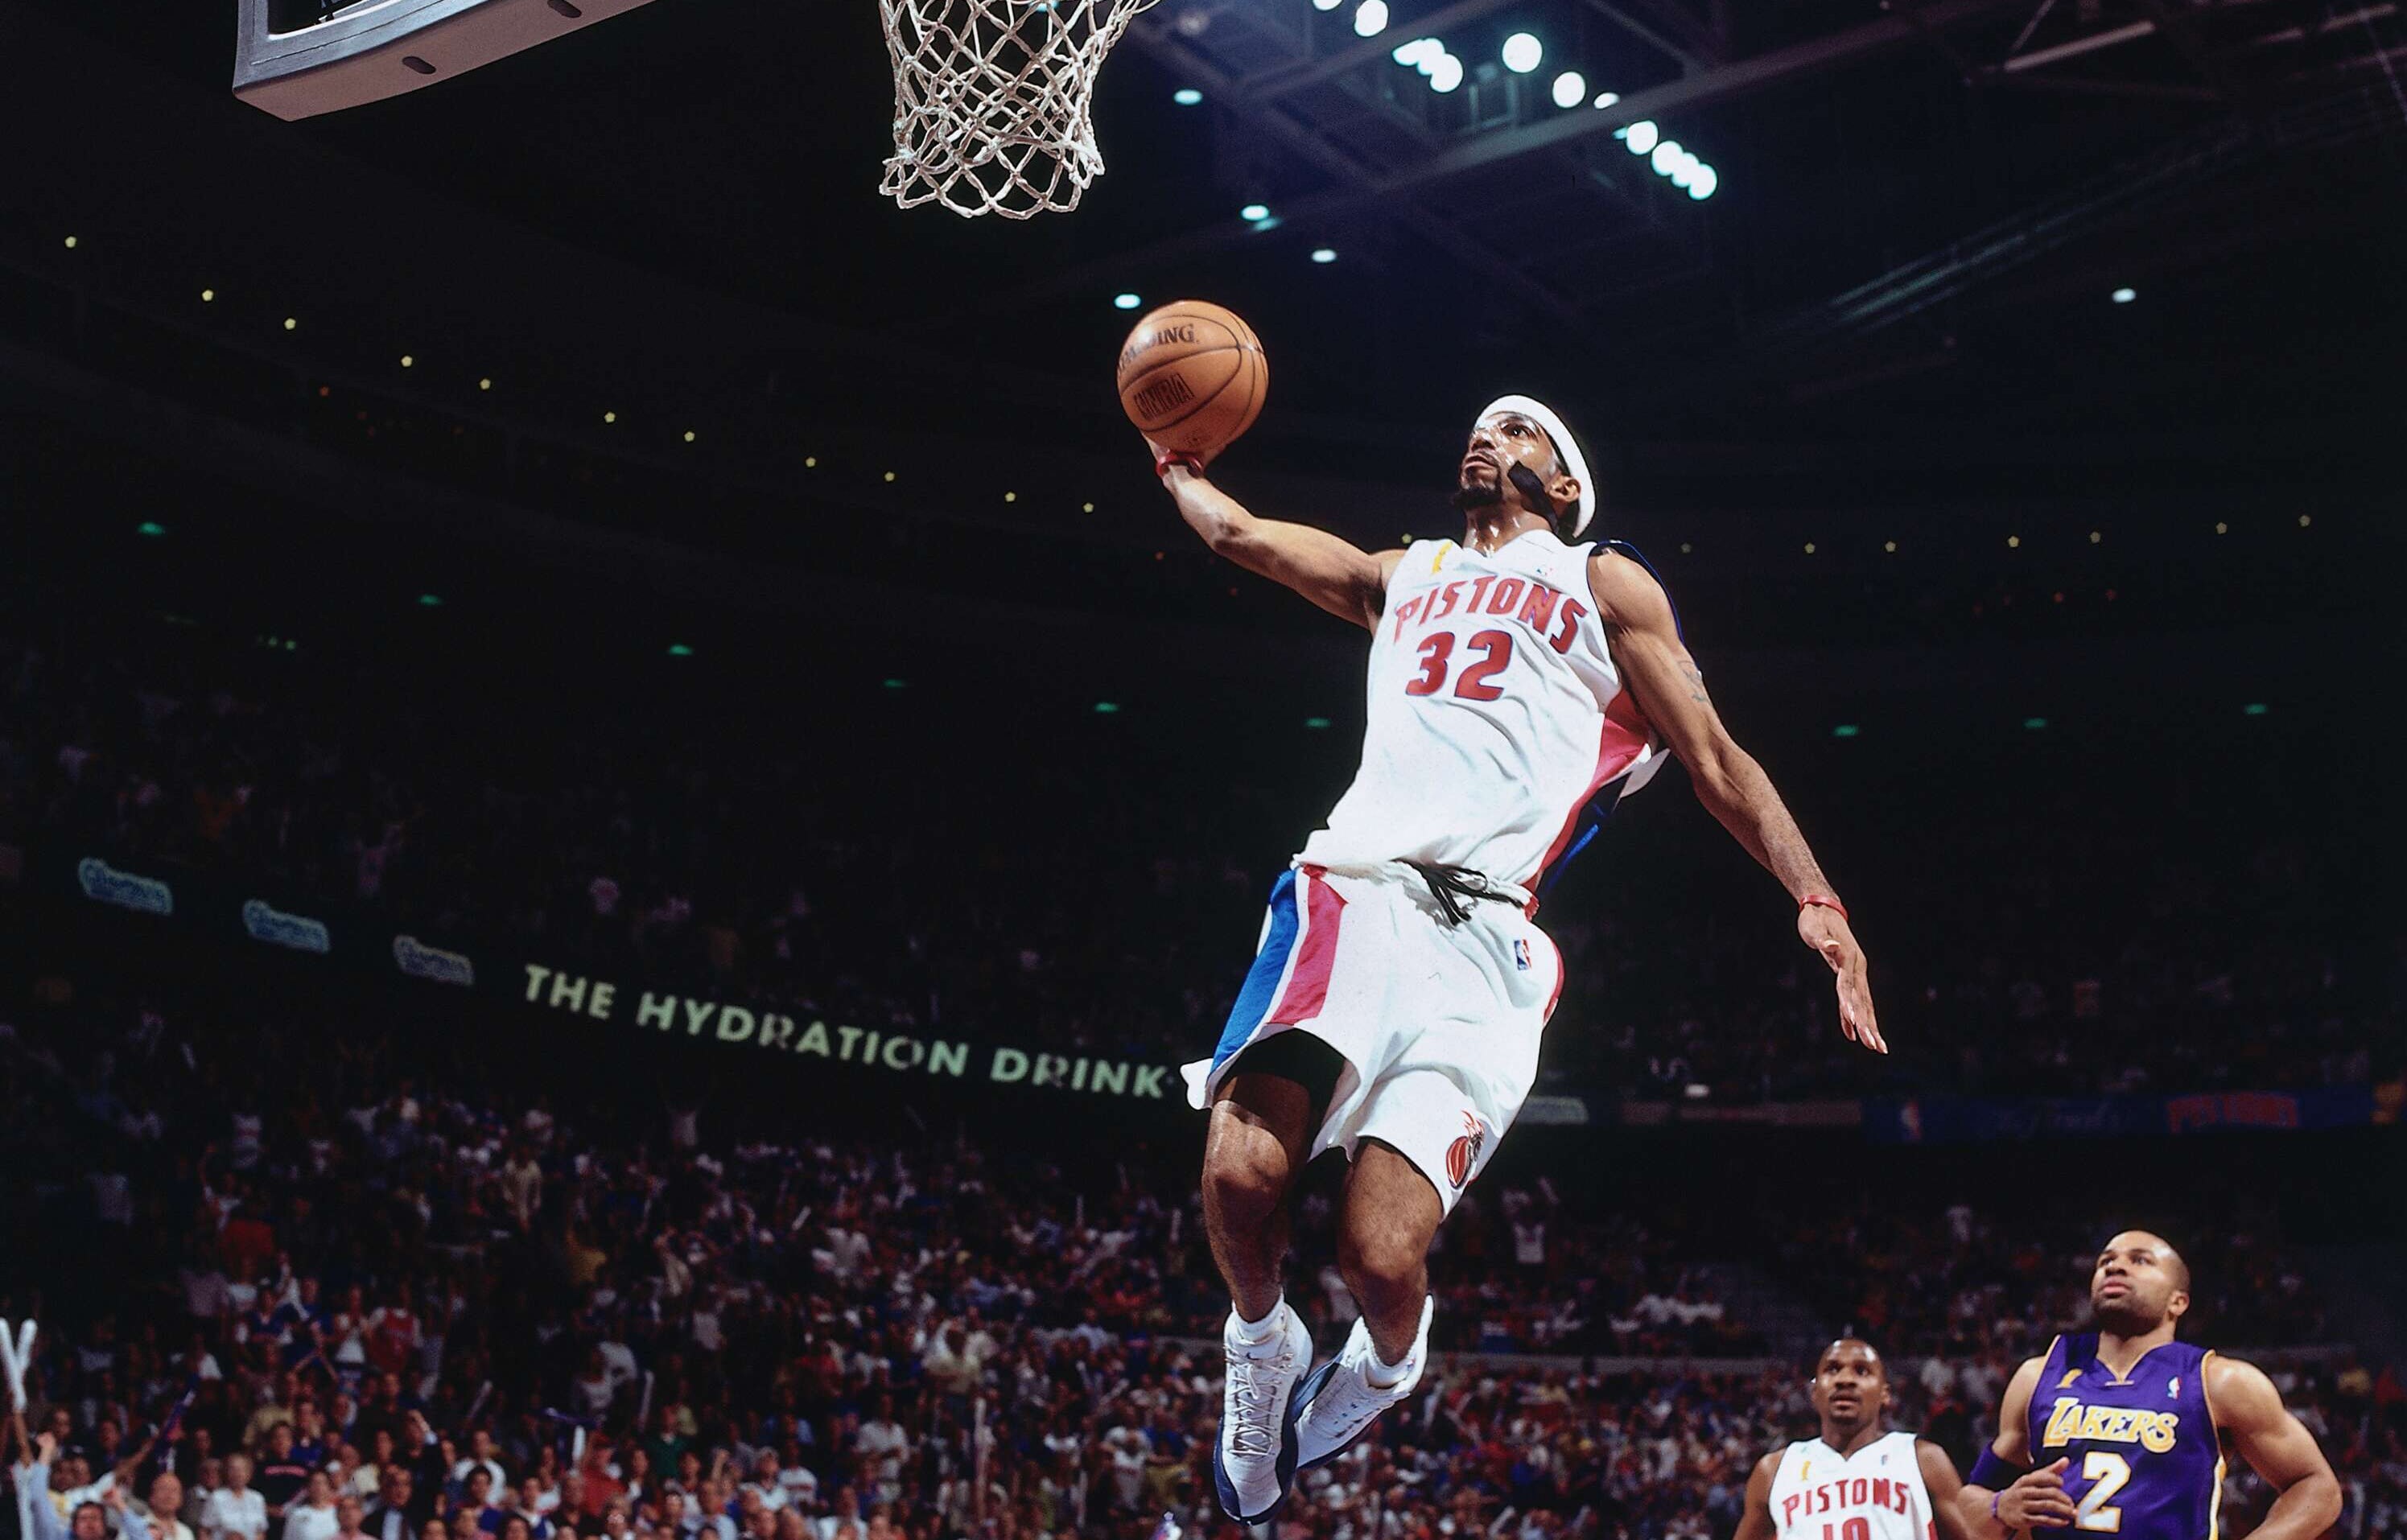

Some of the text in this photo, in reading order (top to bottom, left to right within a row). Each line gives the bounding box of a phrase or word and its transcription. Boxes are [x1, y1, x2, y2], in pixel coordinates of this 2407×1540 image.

[1395, 575, 1588, 654] PISTONS
[1406, 630, 1513, 701] 32
[525, 964, 1168, 1098] THE HYDRATION DRINK
[2042, 1397, 2179, 1454] LAKERS
[1783, 1478, 1909, 1528] PISTONS
[2075, 1451, 2131, 1533] 2
